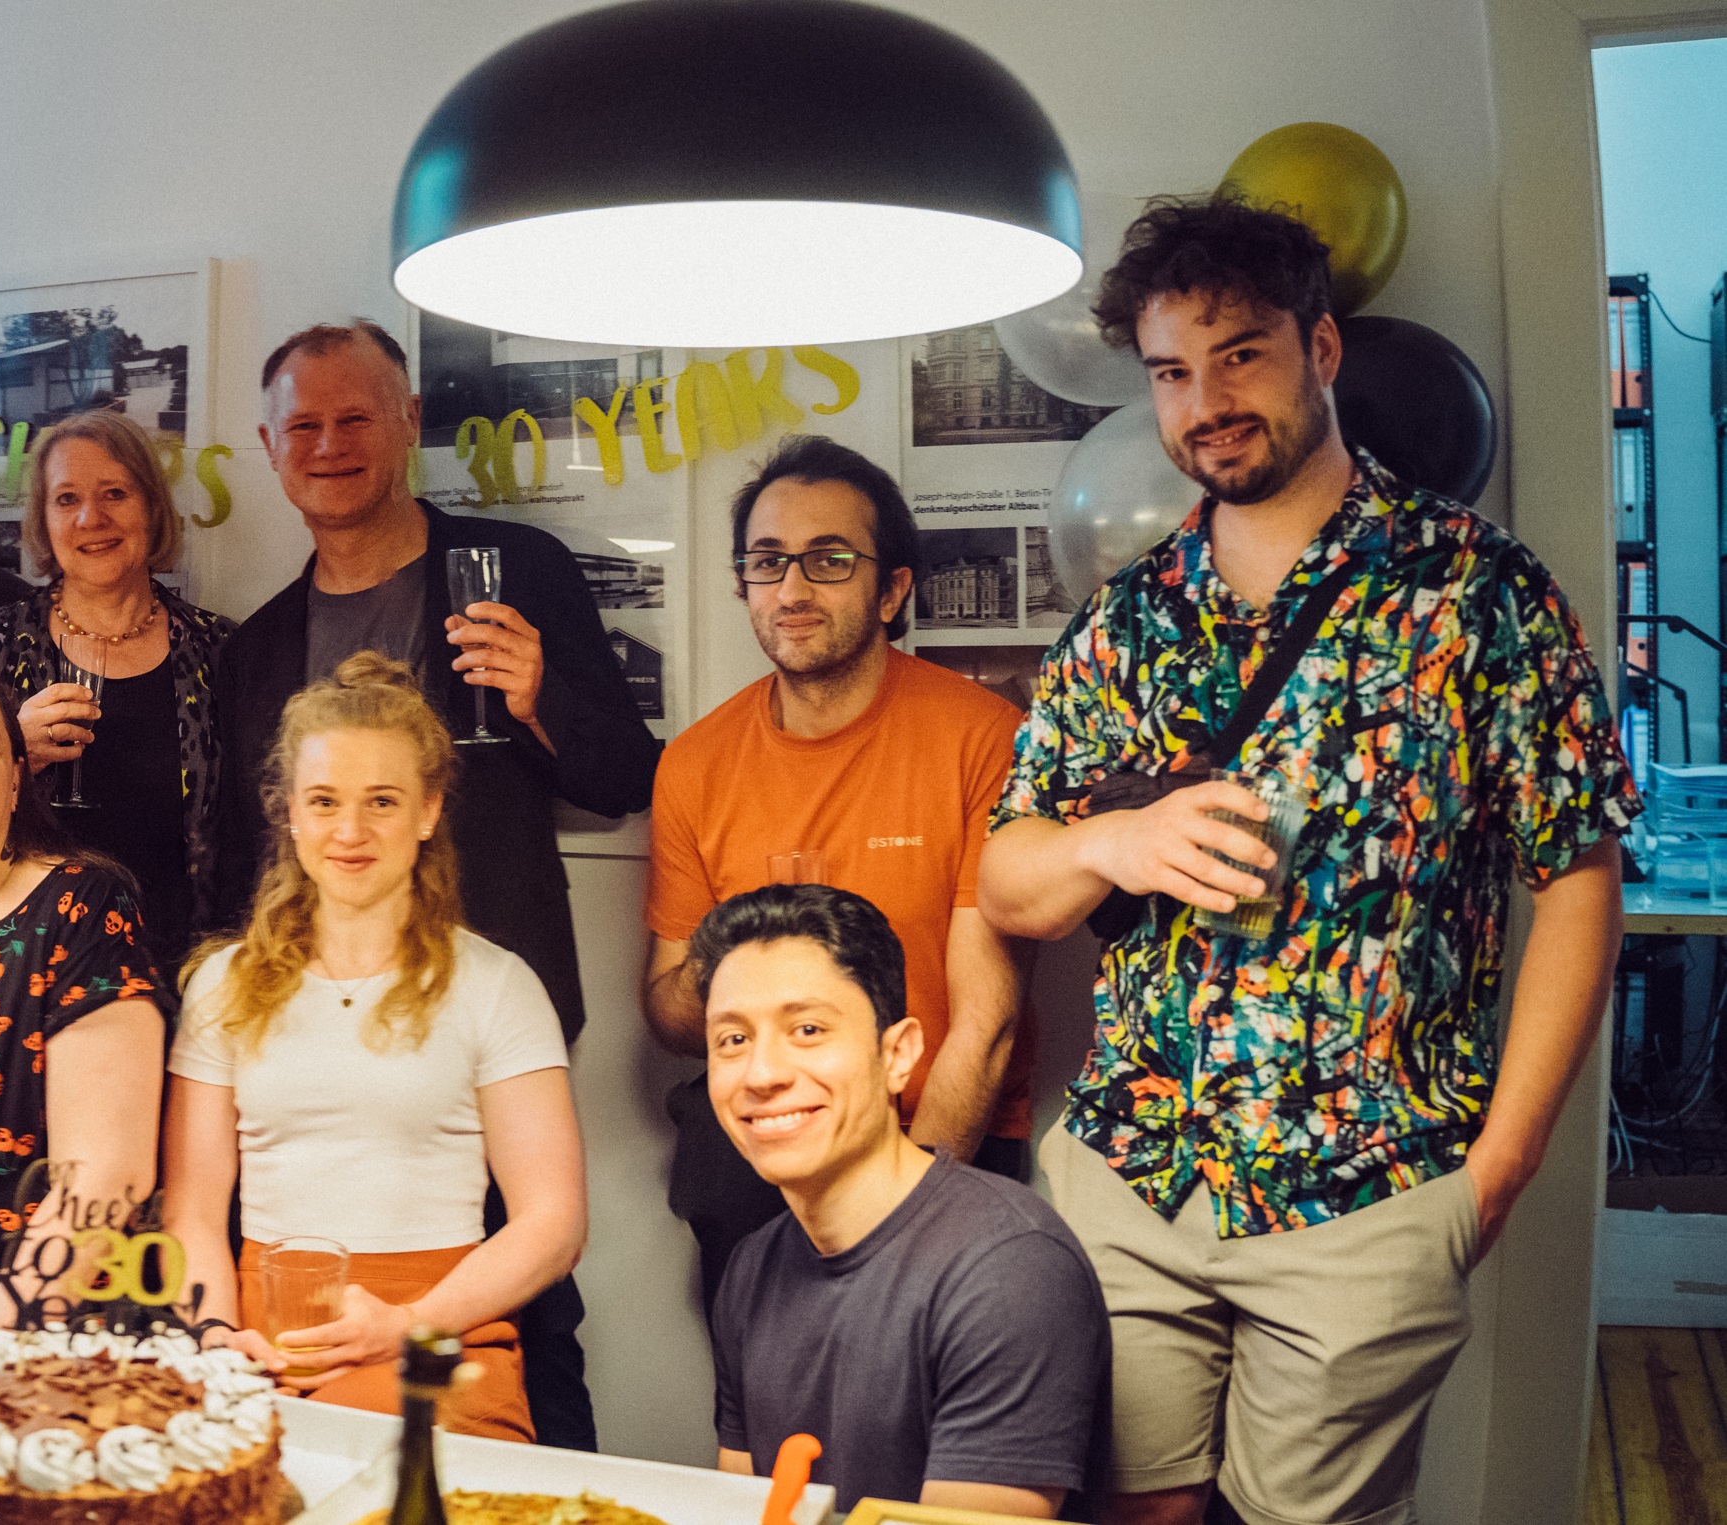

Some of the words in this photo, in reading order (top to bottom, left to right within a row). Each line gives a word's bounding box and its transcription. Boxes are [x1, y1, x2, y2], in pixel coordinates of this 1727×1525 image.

[456, 408, 547, 508] 30
[574, 345, 861, 486] YEARS
[913, 502, 1007, 515] denkmalgeschützter
[68, 1228, 187, 1307] 30
